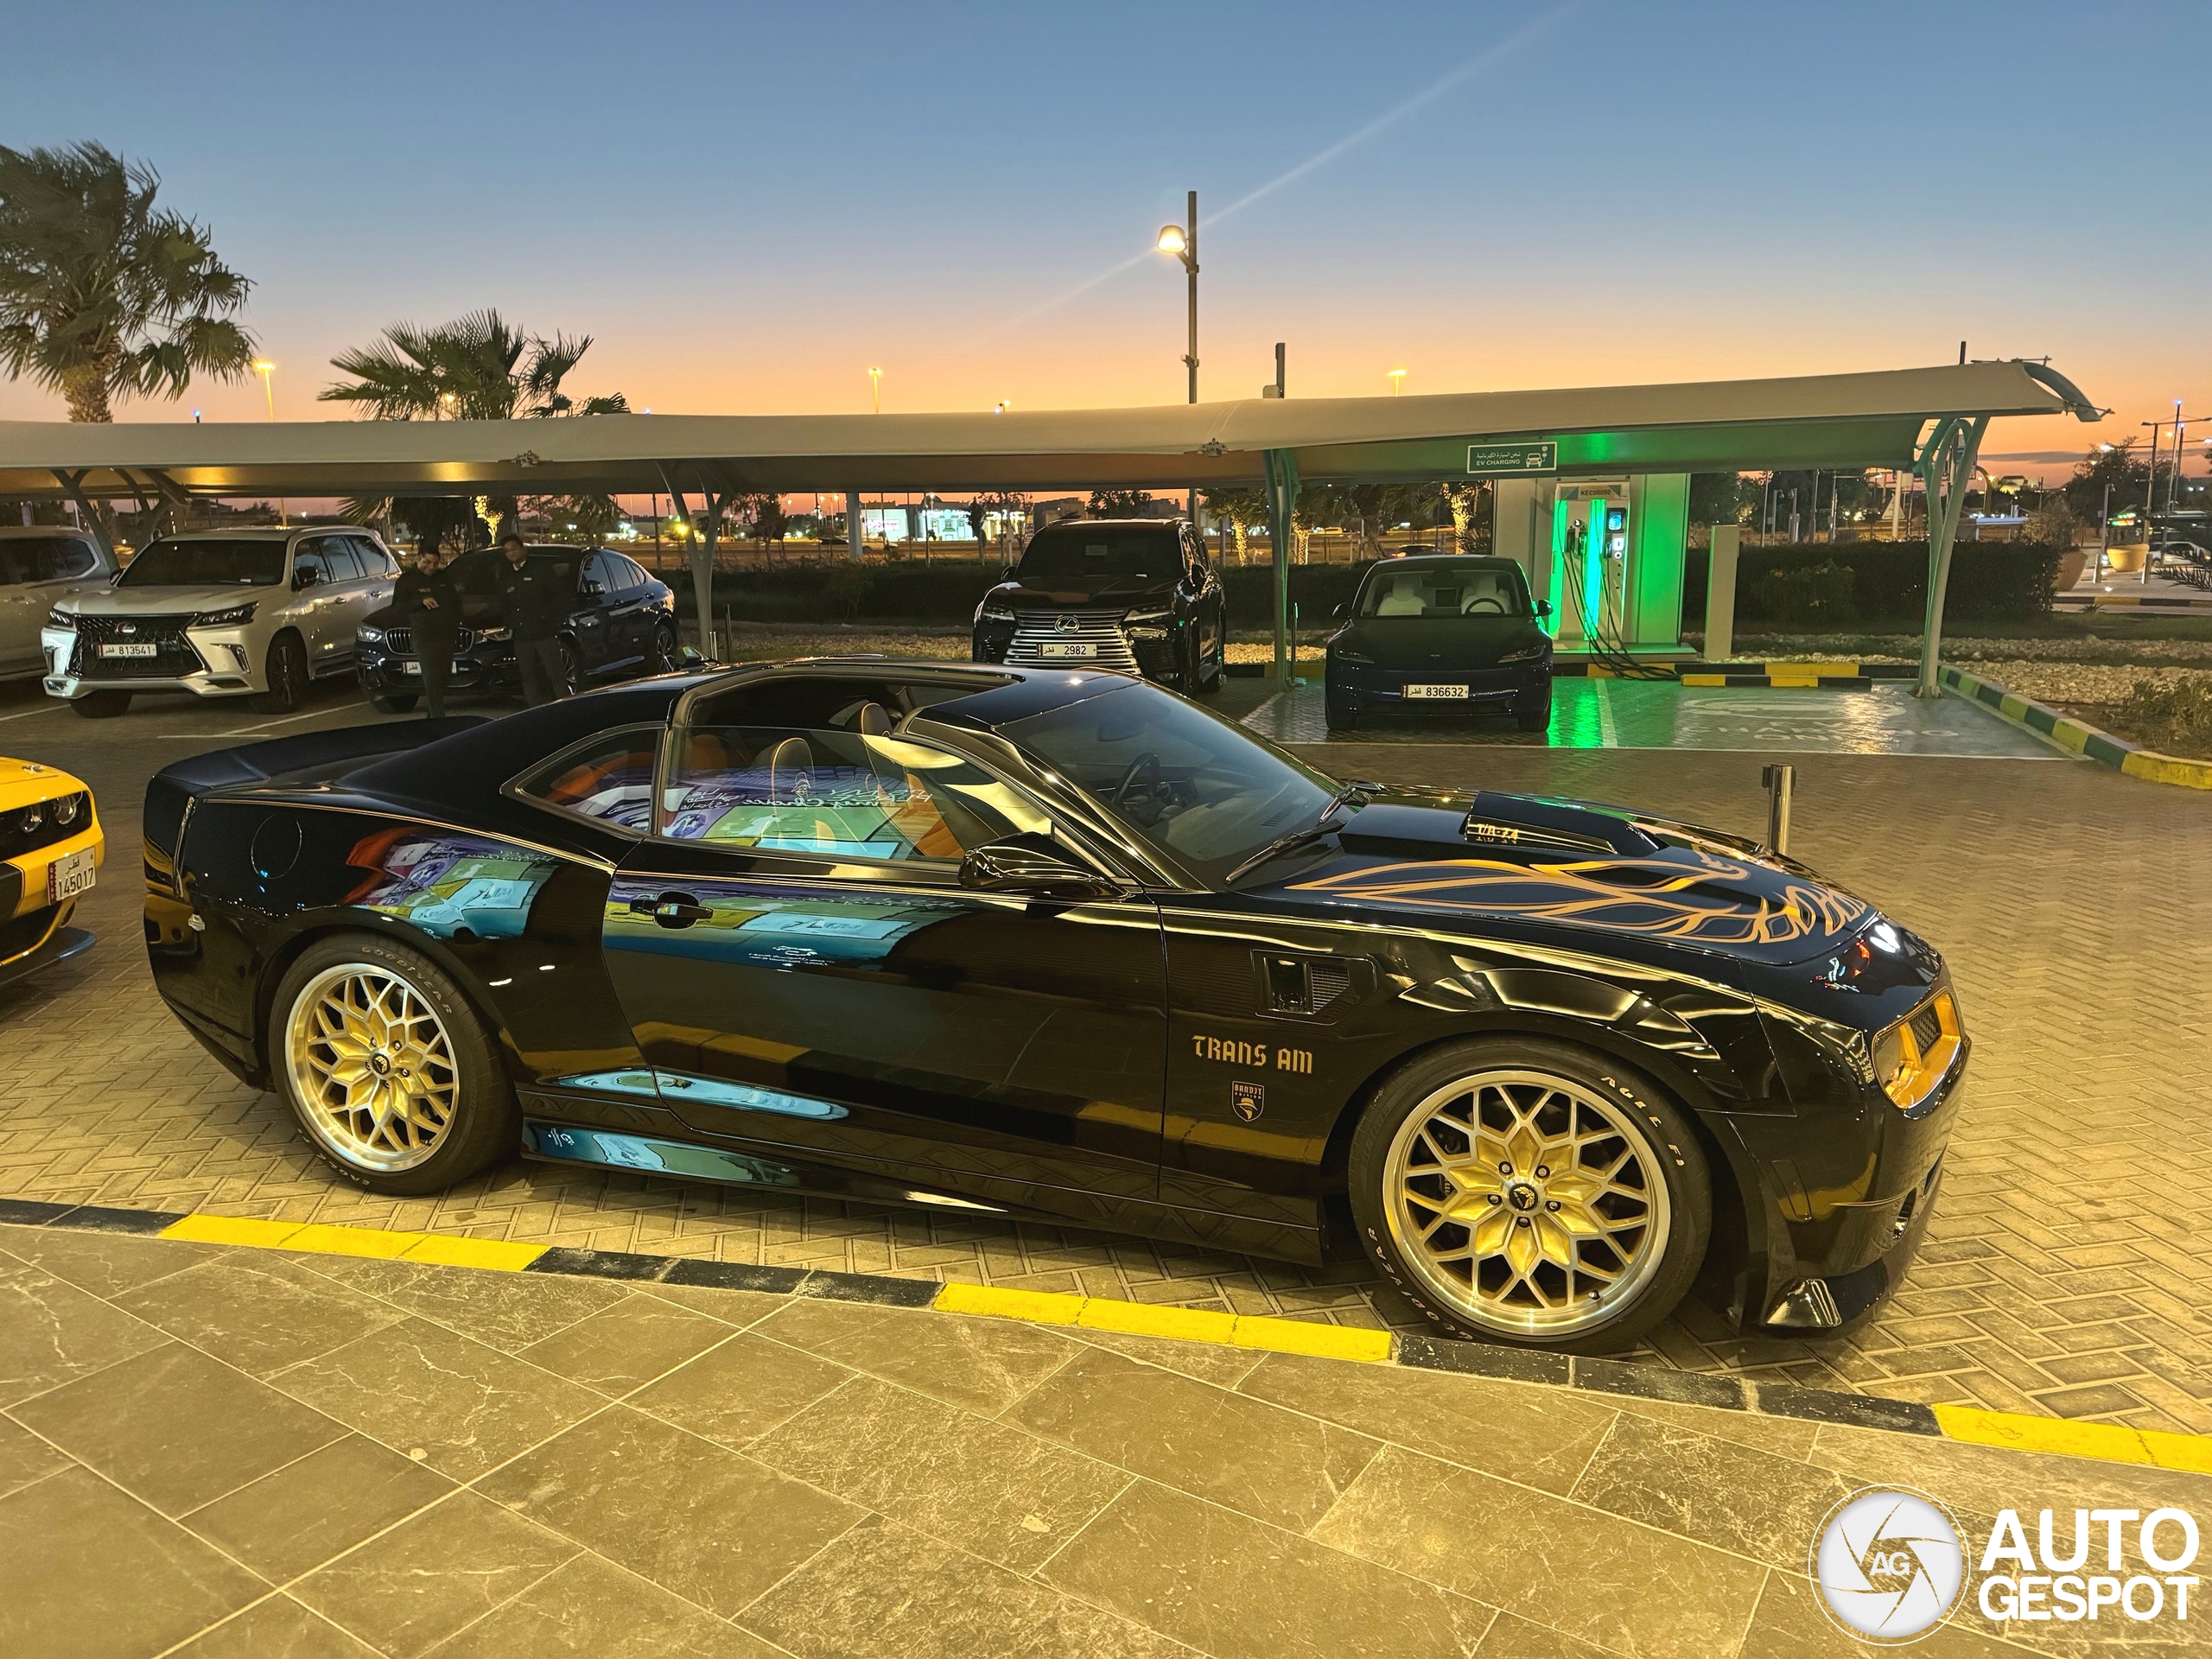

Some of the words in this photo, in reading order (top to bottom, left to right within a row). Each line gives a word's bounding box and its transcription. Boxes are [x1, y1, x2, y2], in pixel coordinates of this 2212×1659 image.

[118, 645, 151, 655] 813541
[1064, 645, 1087, 655] 2982
[1409, 687, 1422, 696] قطر
[1426, 687, 1464, 697] 836632
[65, 855, 80, 874] قطر
[58, 867, 94, 899] 145017
[361, 946, 453, 1014] GOODYEAR
[1192, 1035, 1268, 1067] TRANS
[1277, 1047, 1313, 1074] AM
[1368, 1227, 1474, 1340] GOODYEAR
